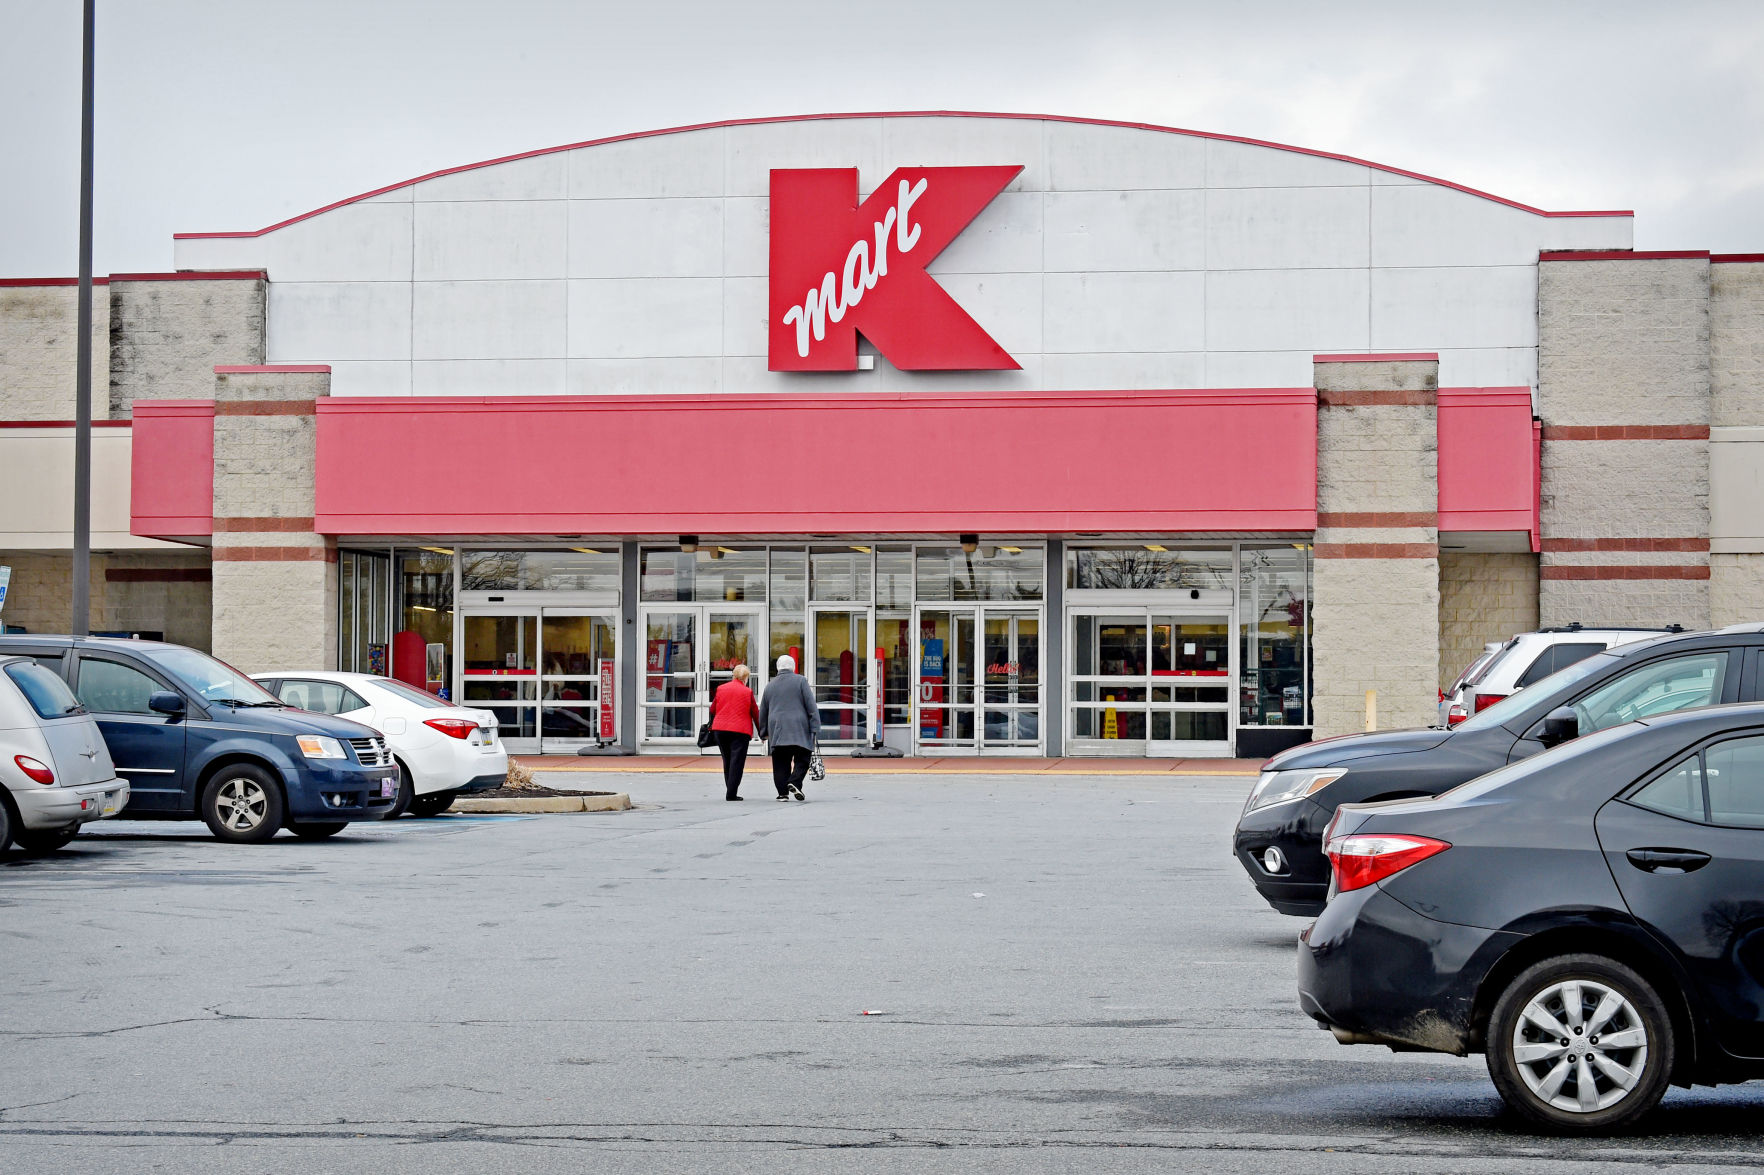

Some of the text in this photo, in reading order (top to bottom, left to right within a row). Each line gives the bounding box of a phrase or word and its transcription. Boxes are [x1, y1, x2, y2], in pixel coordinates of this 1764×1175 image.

[768, 165, 1025, 371] K
[783, 178, 927, 357] mart
[648, 644, 666, 668] #1
